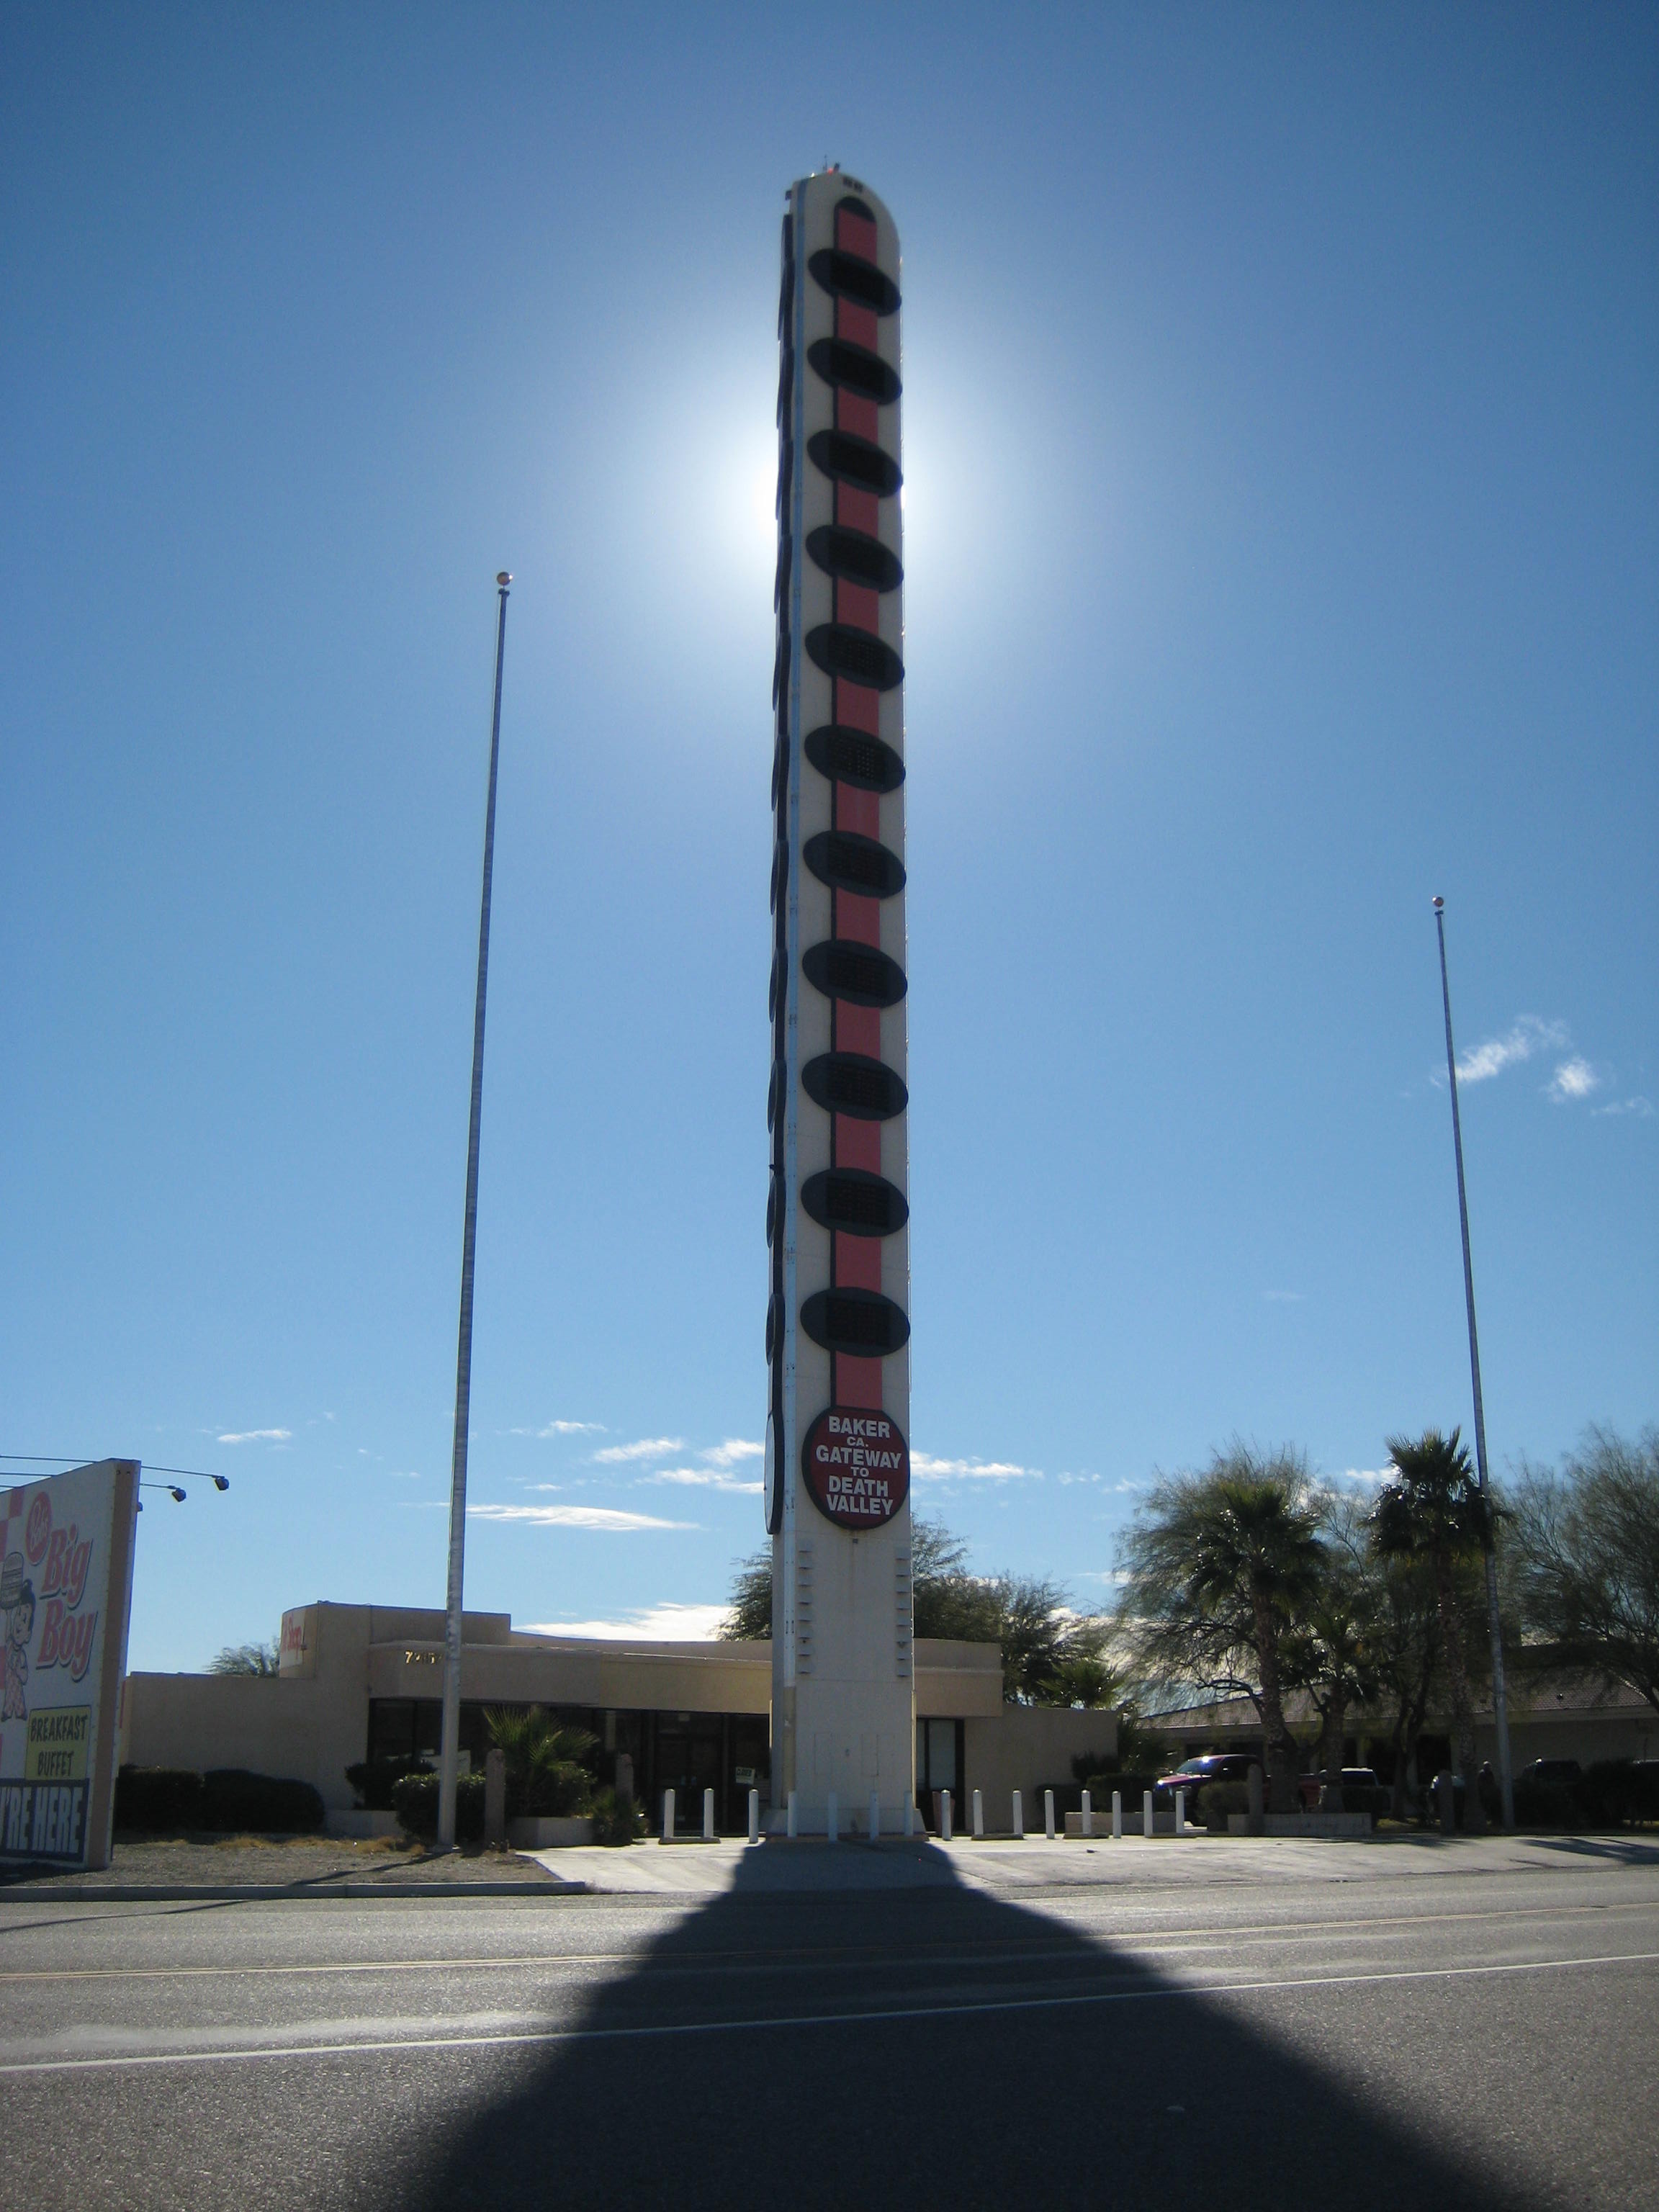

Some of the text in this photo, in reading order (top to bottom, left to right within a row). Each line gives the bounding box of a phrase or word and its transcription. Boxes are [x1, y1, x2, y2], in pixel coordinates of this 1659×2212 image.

[829, 1416, 890, 1438] BAKER
[846, 1437, 868, 1447] CA.
[816, 1445, 902, 1469] GATEWAY
[850, 1467, 869, 1477] TO
[829, 1475, 888, 1497] DEATH
[826, 1494, 893, 1515] VALLEY
[40, 1523, 91, 1608] Big
[37, 1598, 96, 1680] Boy
[30, 1714, 88, 1742] BREAKFAST
[37, 1750, 74, 1776] BUFFET
[32, 1786, 83, 1853] HERE
